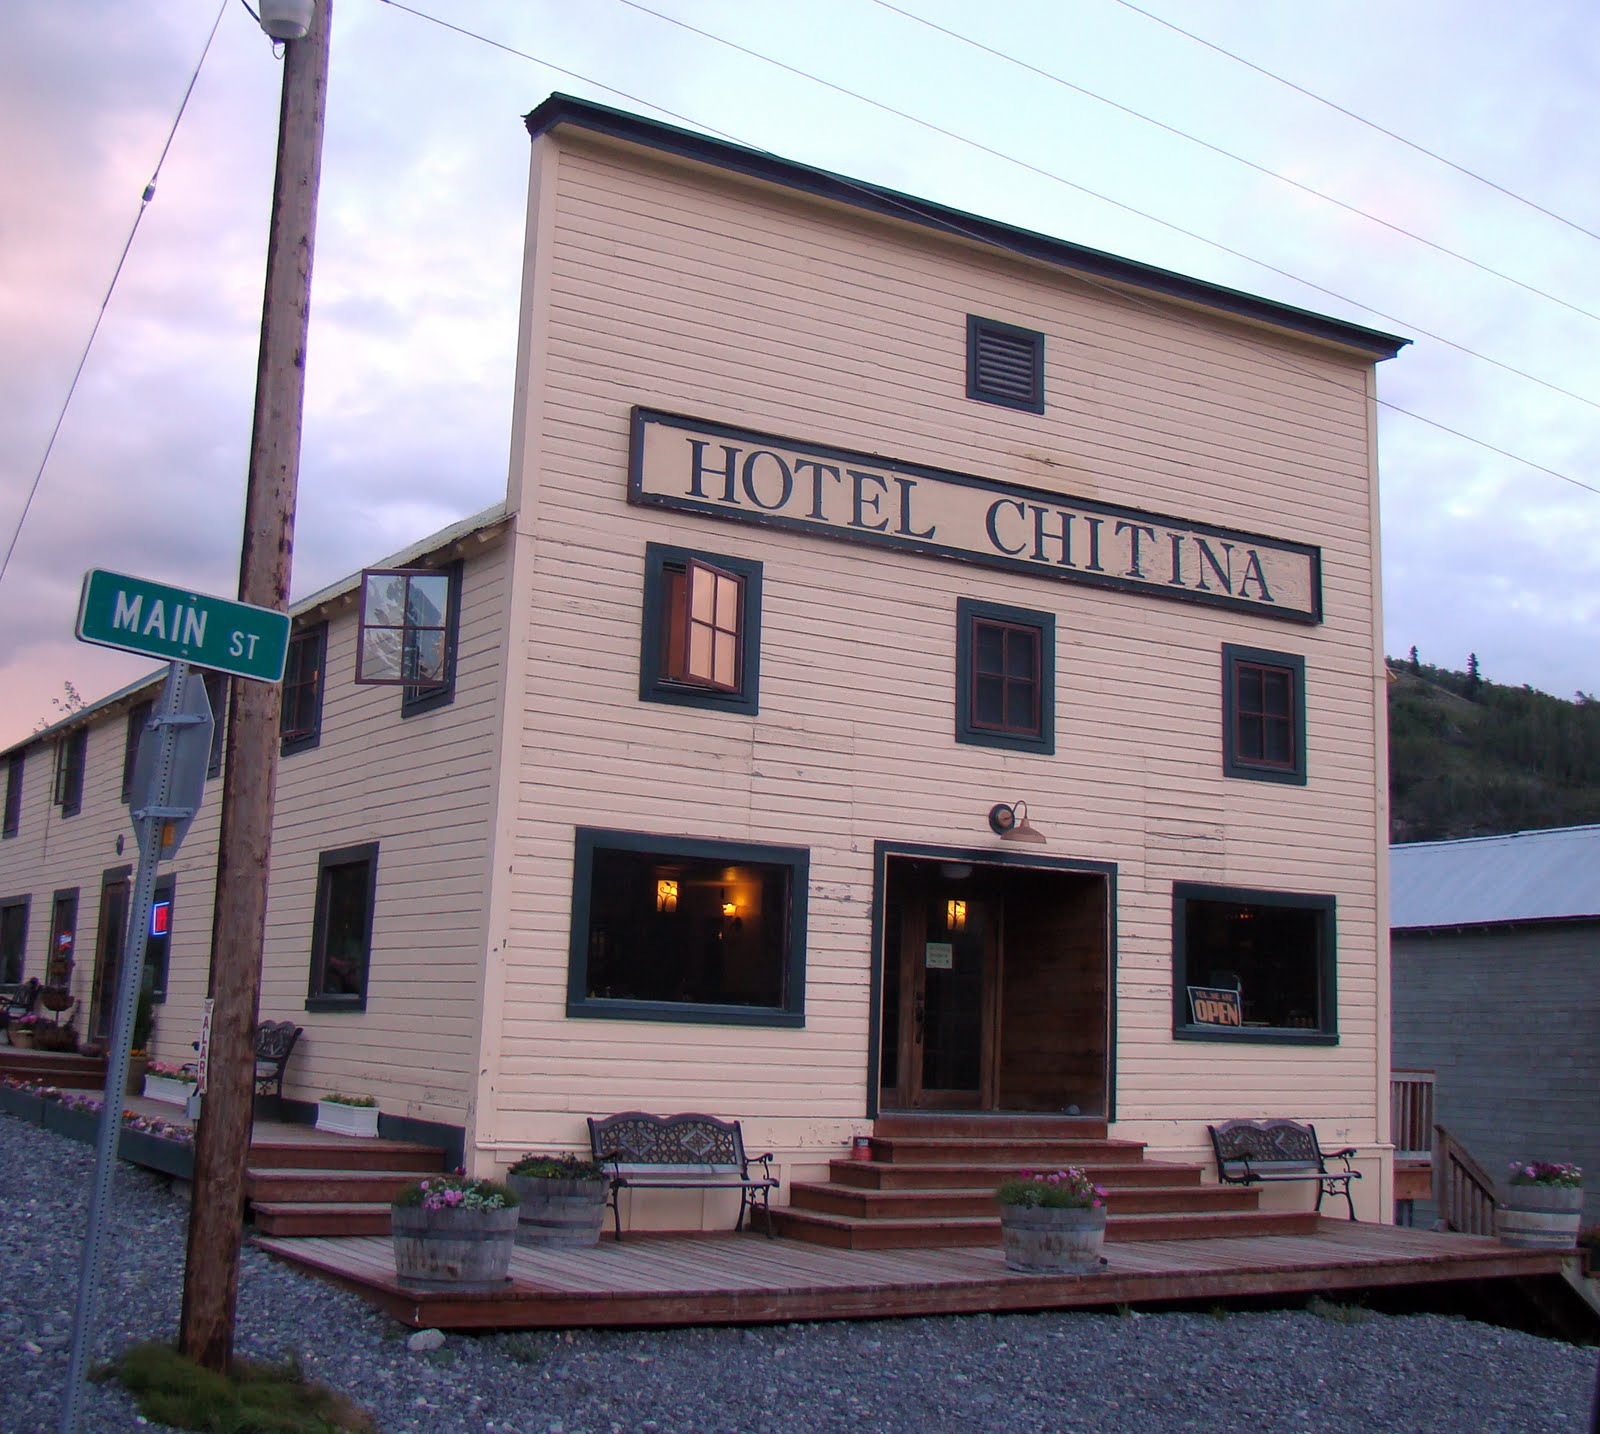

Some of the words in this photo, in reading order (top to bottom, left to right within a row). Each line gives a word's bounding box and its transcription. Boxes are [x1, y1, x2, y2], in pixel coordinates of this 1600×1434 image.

[686, 438, 936, 539] HOTEL
[985, 498, 1273, 602] CHITINA
[113, 591, 208, 648] MAIN
[229, 631, 260, 659] ST
[1195, 999, 1239, 1026] OPEN
